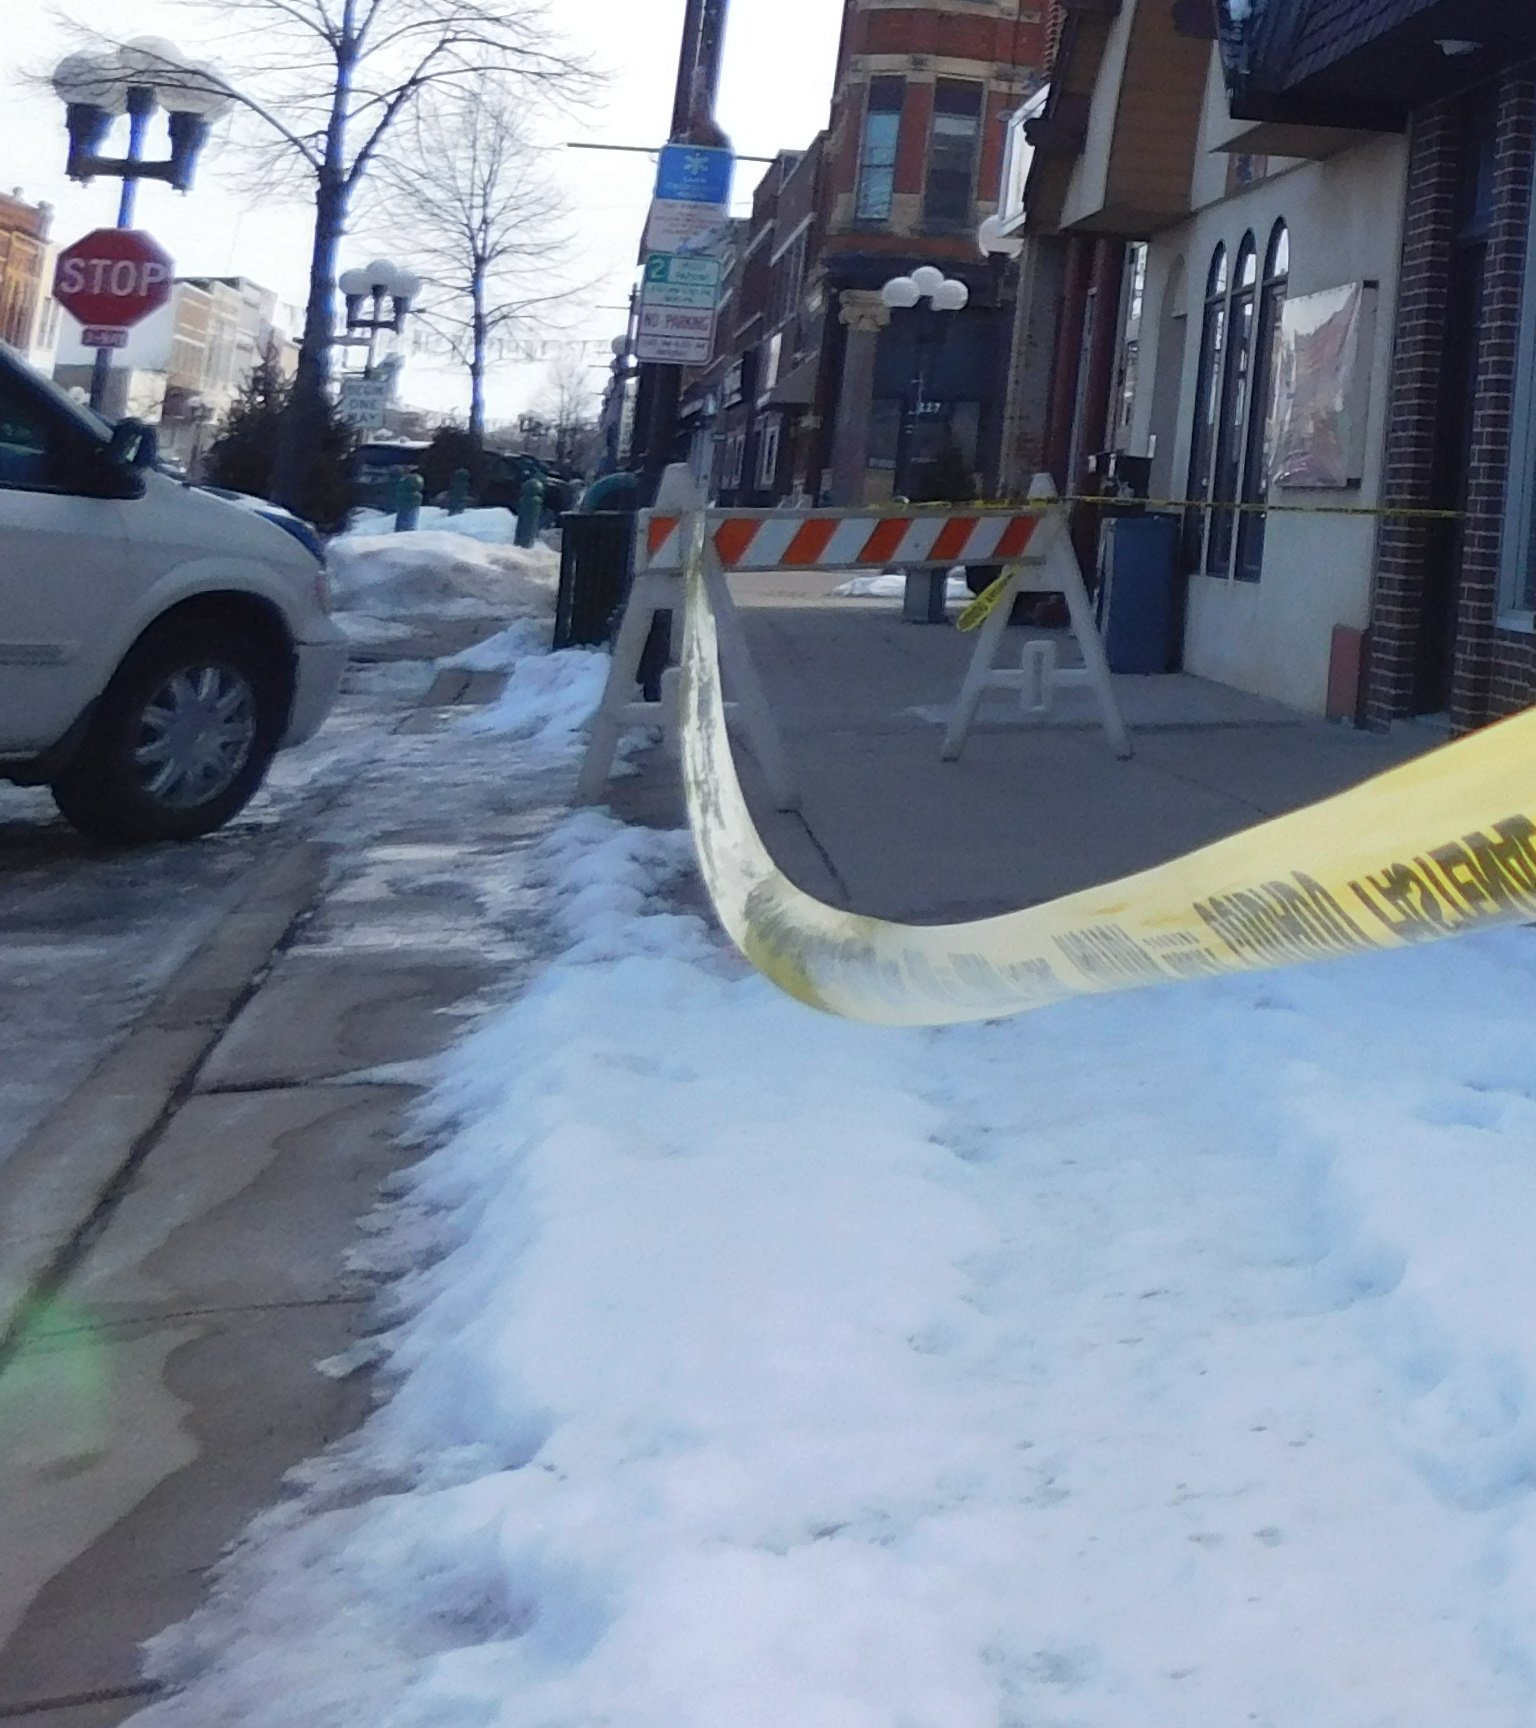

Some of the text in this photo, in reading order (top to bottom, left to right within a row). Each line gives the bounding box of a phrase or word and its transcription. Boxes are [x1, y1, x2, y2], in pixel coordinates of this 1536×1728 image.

[60, 257, 166, 296] STOP
[649, 259, 666, 281] 2
[643, 313, 711, 332] NO PARKING
[349, 398, 379, 410] ONE
